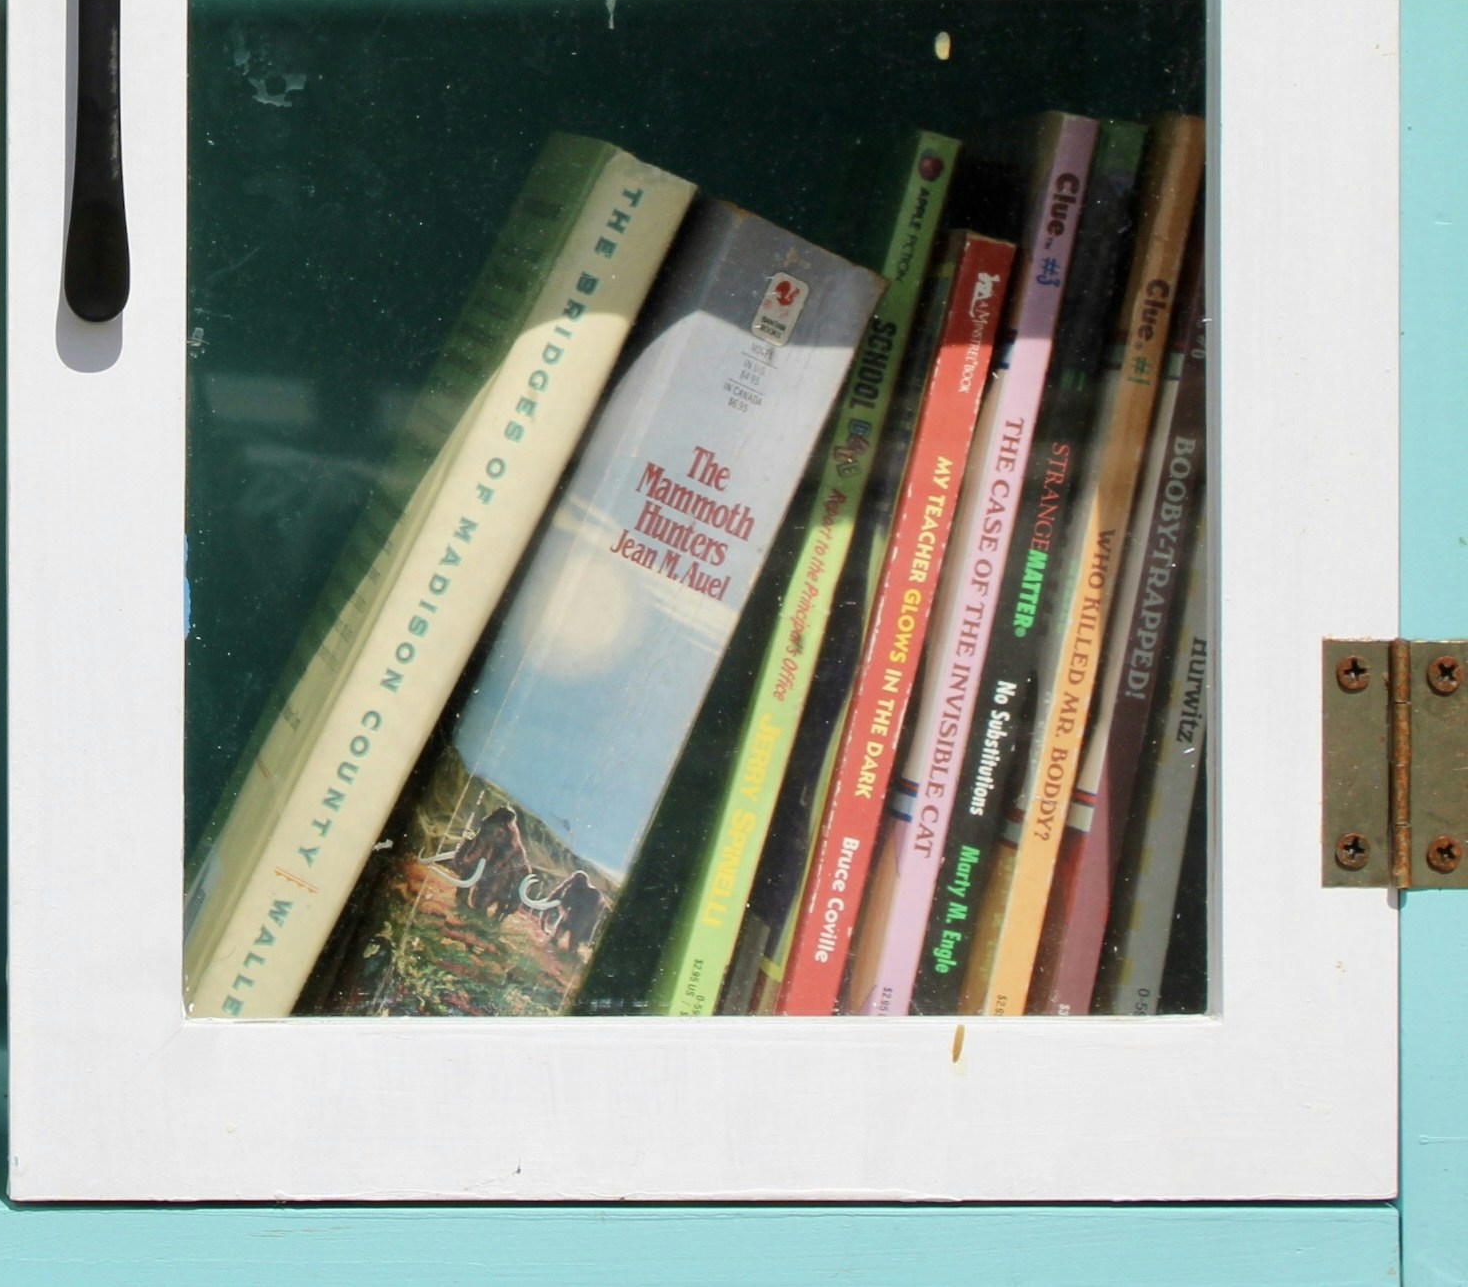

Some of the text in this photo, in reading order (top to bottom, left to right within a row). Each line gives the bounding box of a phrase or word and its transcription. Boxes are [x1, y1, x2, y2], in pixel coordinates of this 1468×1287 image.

[594, 186, 642, 260] THE
[502, 271, 599, 444] BRIDGES
[847, 316, 898, 412] SCHOOL
[957, 363, 975, 394] BOOK
[474, 456, 506, 506] OF
[634, 461, 756, 542] Mammoth
[684, 445, 735, 493] The
[913, 172, 1080, 860] Clue #3 THE CASE OF THE INVISIBLE CAT
[609, 528, 735, 602] Jean M. Auel
[634, 498, 730, 568] Hunters
[808, 555, 826, 583] the
[814, 539, 830, 556] to
[1034, 279, 1170, 843] Clue #1 WHO KILLED MR. BODDY?
[1125, 435, 1196, 700] BOOBY-TRAPPED!
[379, 517, 478, 691] MADISON
[855, 456, 953, 799] MY TEACHER GLOWS IN THE DARK
[772, 656, 800, 702] Office
[294, 707, 384, 870] COUNTY
[969, 680, 1018, 817] No Substitutions
[702, 714, 784, 927] JERRY SPINELLI
[815, 836, 860, 965] Bruce Coville
[932, 845, 980, 975] Marty M. Engle
